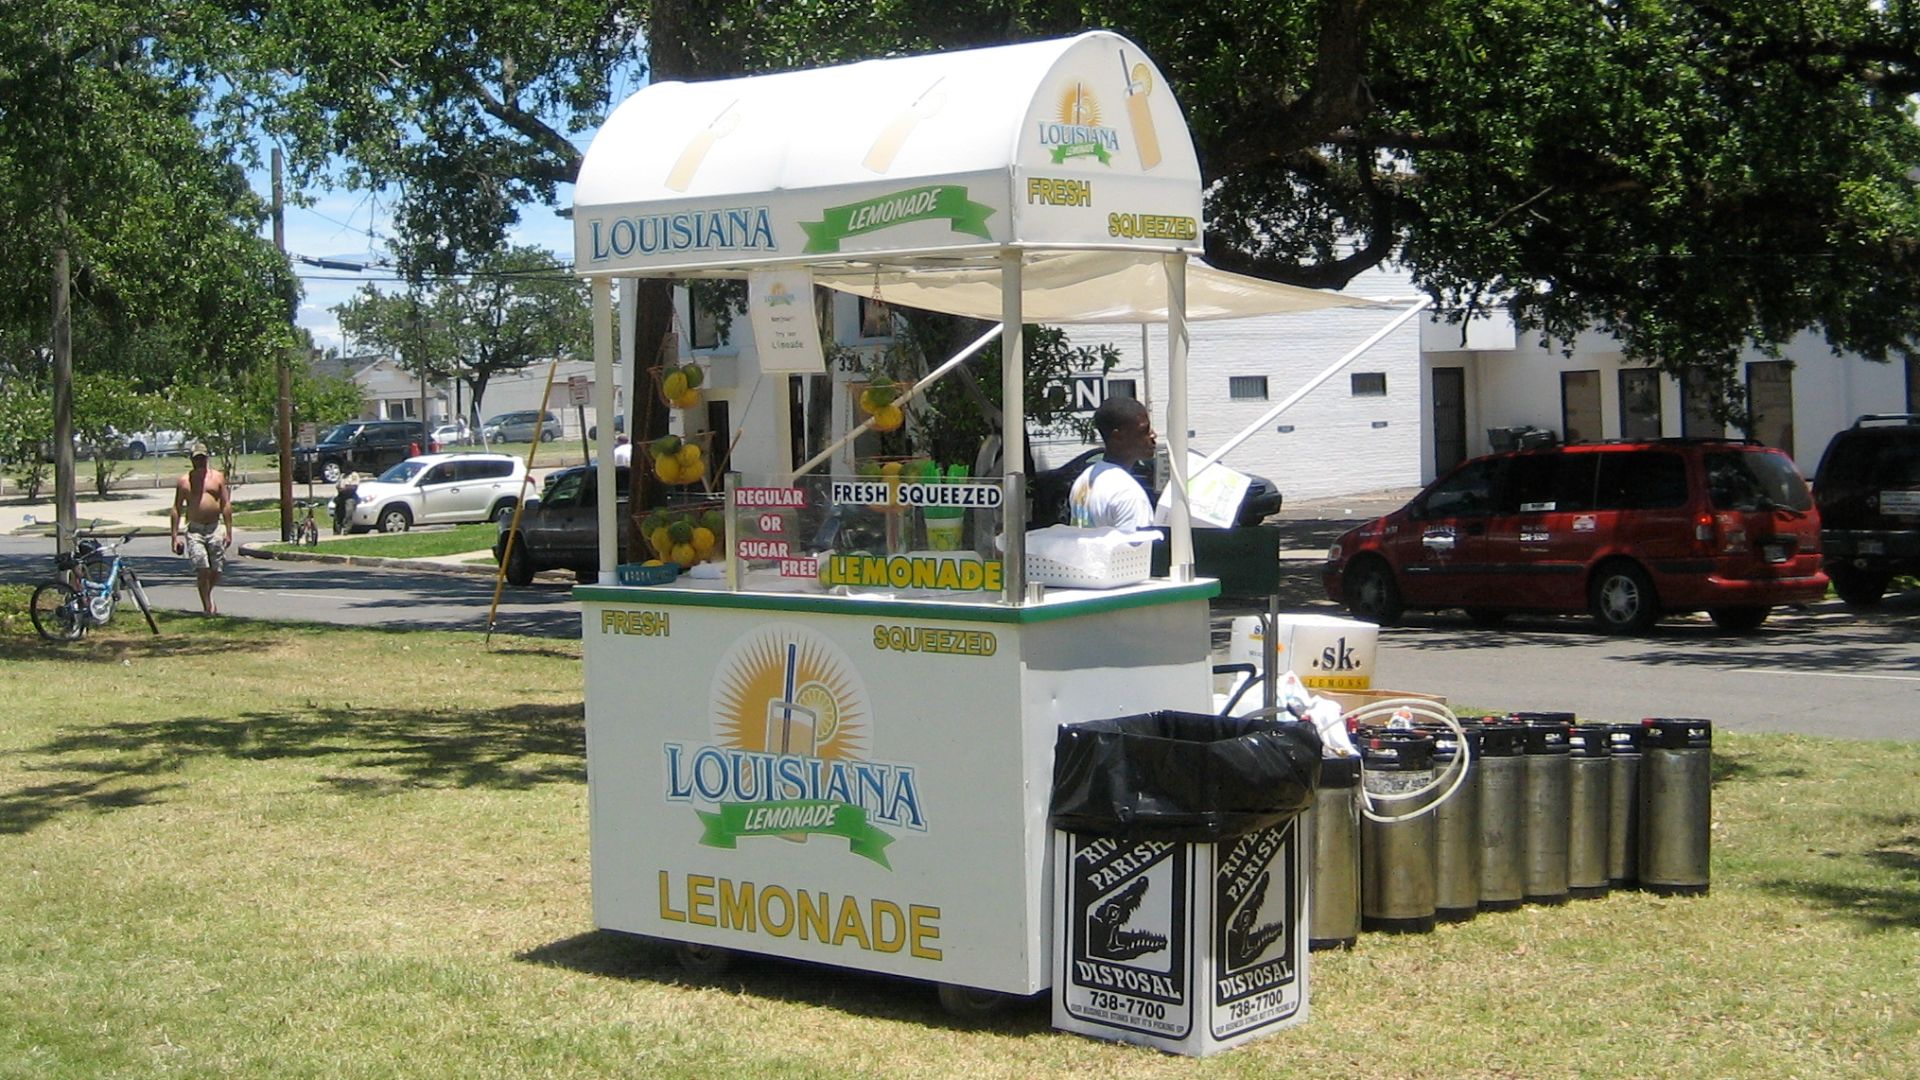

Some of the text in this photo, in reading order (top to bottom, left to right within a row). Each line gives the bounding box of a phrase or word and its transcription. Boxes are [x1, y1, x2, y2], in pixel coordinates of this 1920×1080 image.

[1039, 122, 1120, 151] LOUISIANA
[1027, 177, 1091, 207] FRESH
[847, 188, 942, 231] LEMONADE
[591, 207, 778, 262] LOUISIANA
[1108, 212, 1197, 241] SQUEEZED
[736, 489, 805, 506] REGULAR
[833, 484, 1001, 506] FRESH SQUEEZED
[760, 514, 782, 532] OR
[738, 541, 789, 558] SUGAR
[781, 559, 817, 577] FREE
[830, 555, 1003, 591] LEMONADE
[601, 610, 670, 636] FRESH
[873, 625, 997, 656] SQUEEZED
[1308, 678, 1363, 688] LEMONS
[664, 743, 927, 832] LOUISIANA
[744, 803, 840, 830] LEMONADE
[1082, 837, 1120, 864] RIV
[1226, 828, 1280, 901] PARISH
[1087, 841, 1170, 891] PARISH
[659, 870, 943, 961] LEMONADE
[1076, 960, 1182, 999] DISPOSAL
[1218, 961, 1293, 998] DISPOSAL
[1090, 991, 1165, 1020] 738-7700
[1229, 989, 1283, 1020] 738-7700
